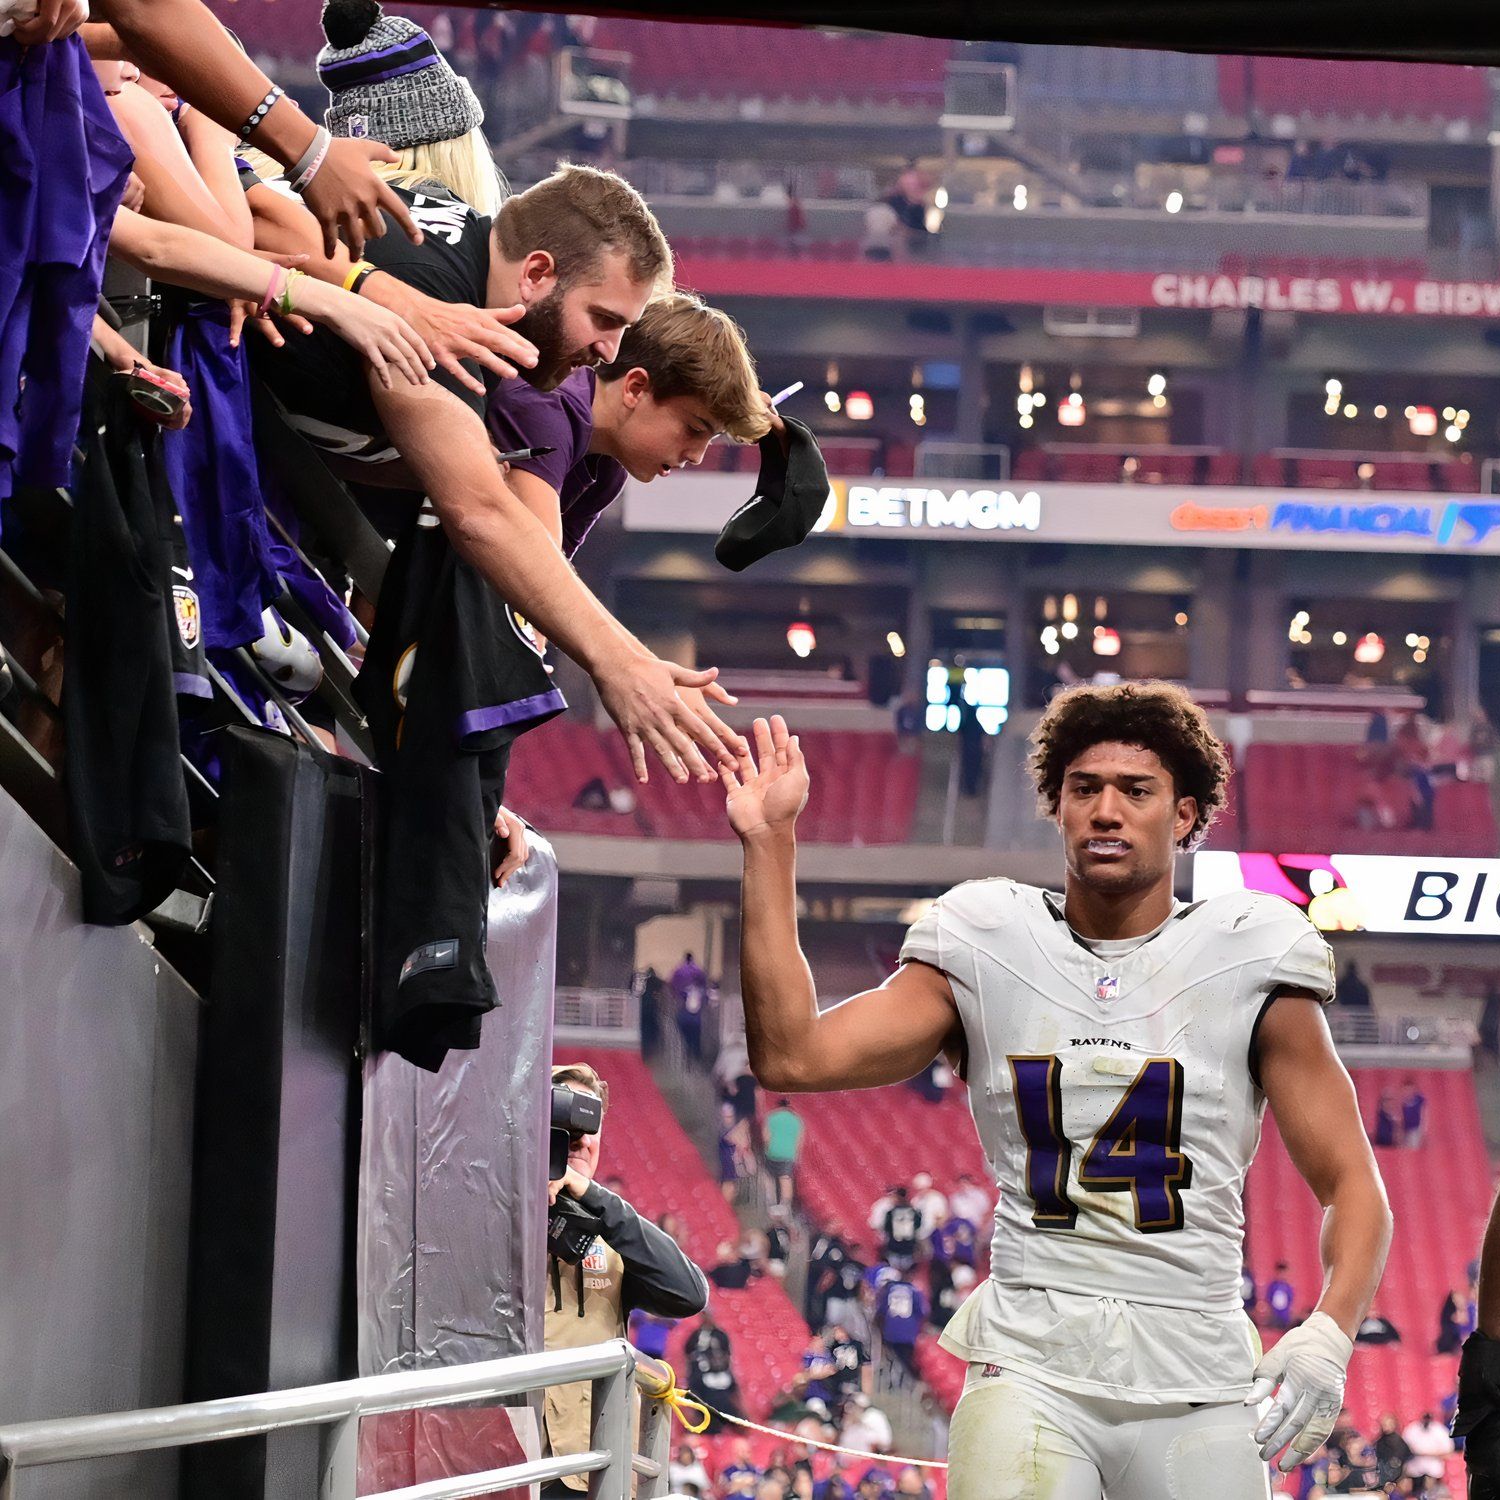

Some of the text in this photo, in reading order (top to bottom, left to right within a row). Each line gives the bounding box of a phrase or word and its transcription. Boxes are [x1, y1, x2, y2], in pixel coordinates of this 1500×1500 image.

[1152, 273, 1342, 312] CHARLES
[1351, 280, 1406, 314] W.
[848, 486, 1041, 531] BETMGM
[1069, 1037, 1132, 1051] RAVENS
[1006, 1054, 1193, 1234] 14
